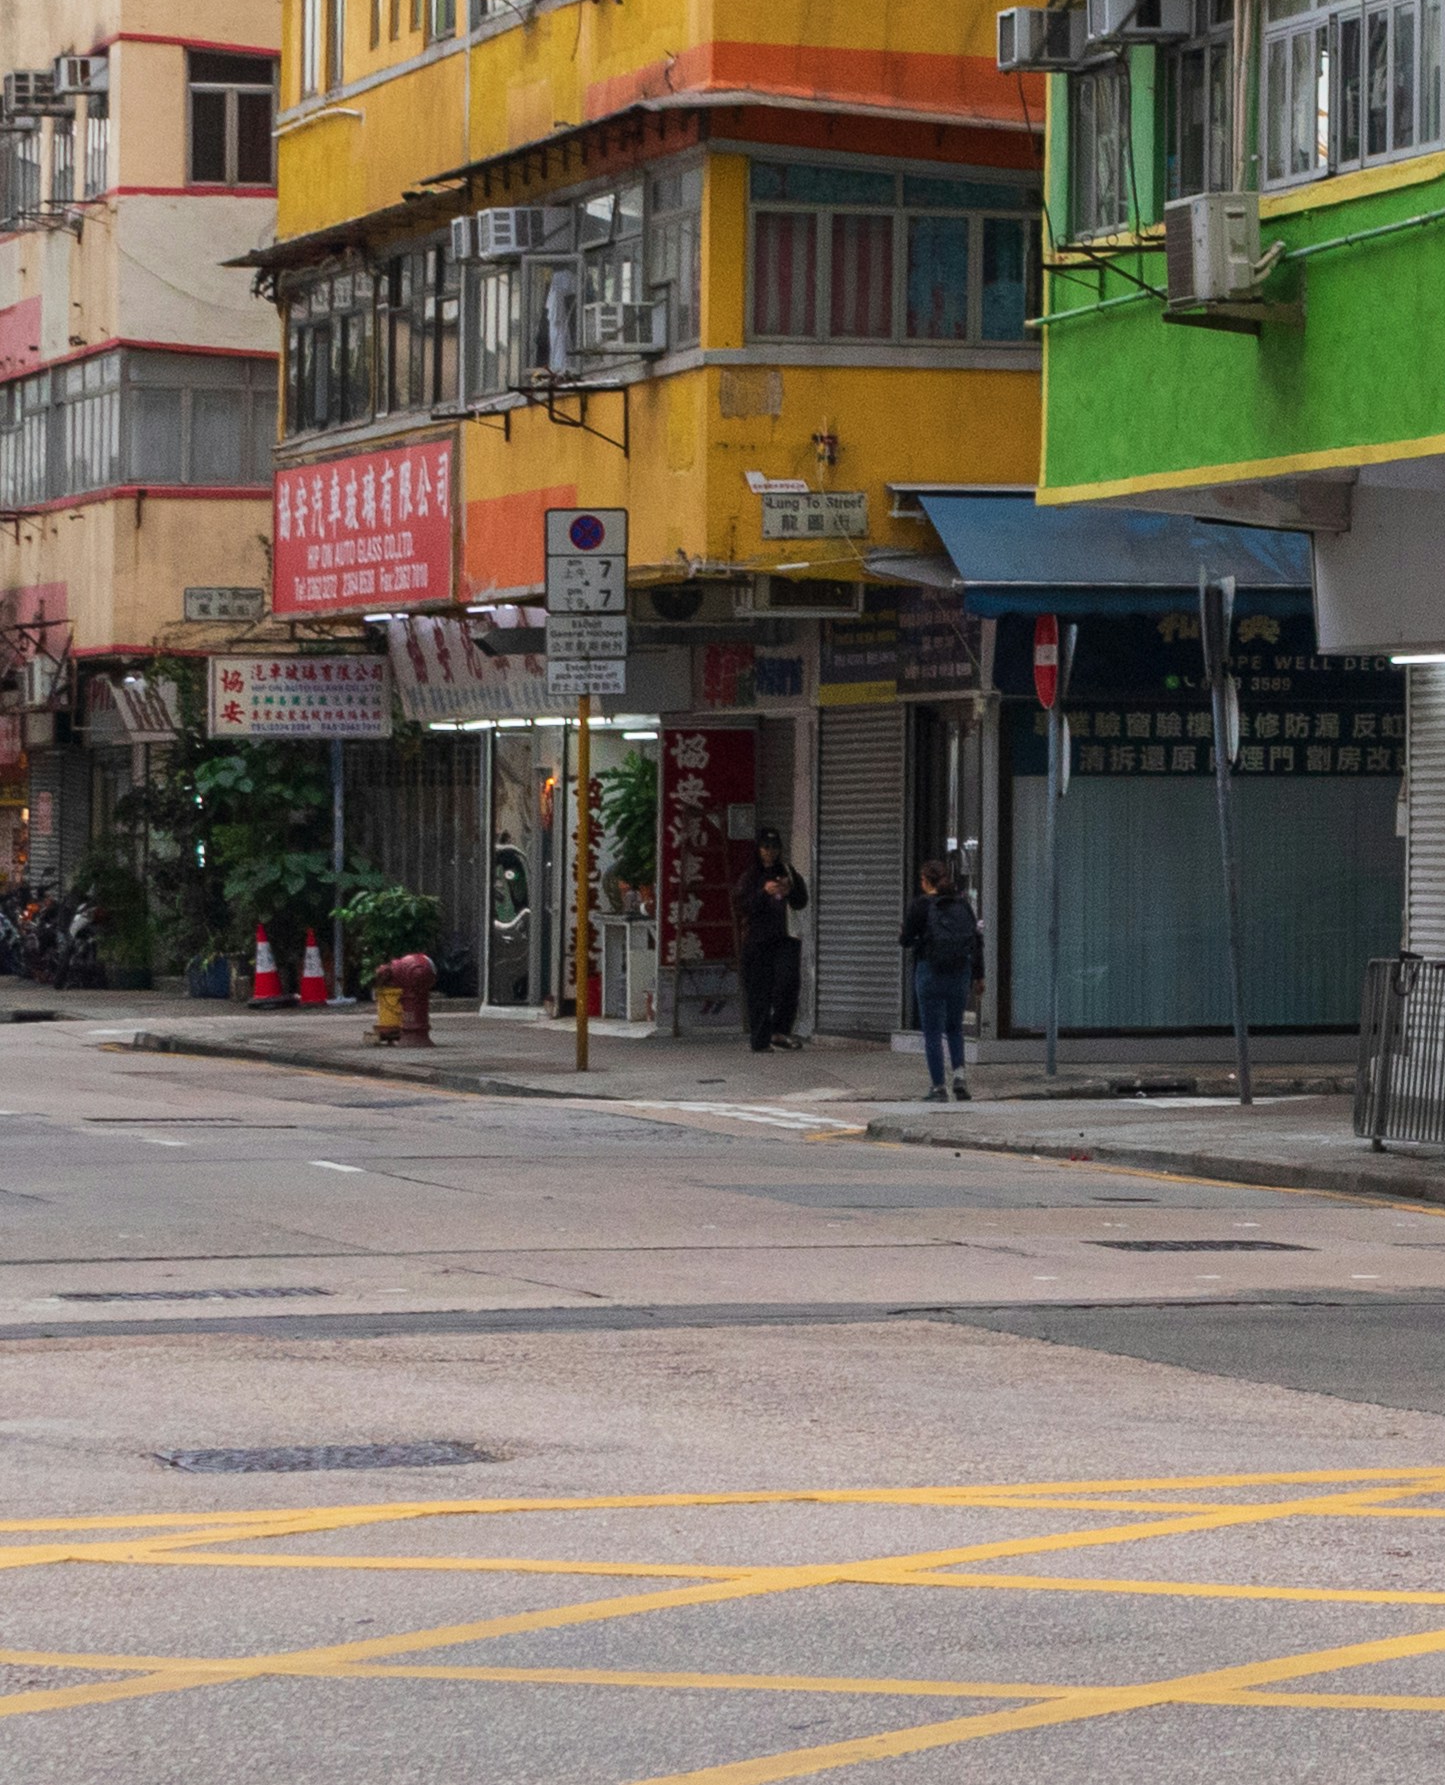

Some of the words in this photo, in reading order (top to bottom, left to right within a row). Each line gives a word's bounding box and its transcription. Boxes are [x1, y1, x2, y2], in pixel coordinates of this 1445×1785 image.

[805, 496, 821, 509] To
[825, 497, 862, 510] Street
[599, 559, 612, 578] 7
[599, 589, 612, 608] 7
